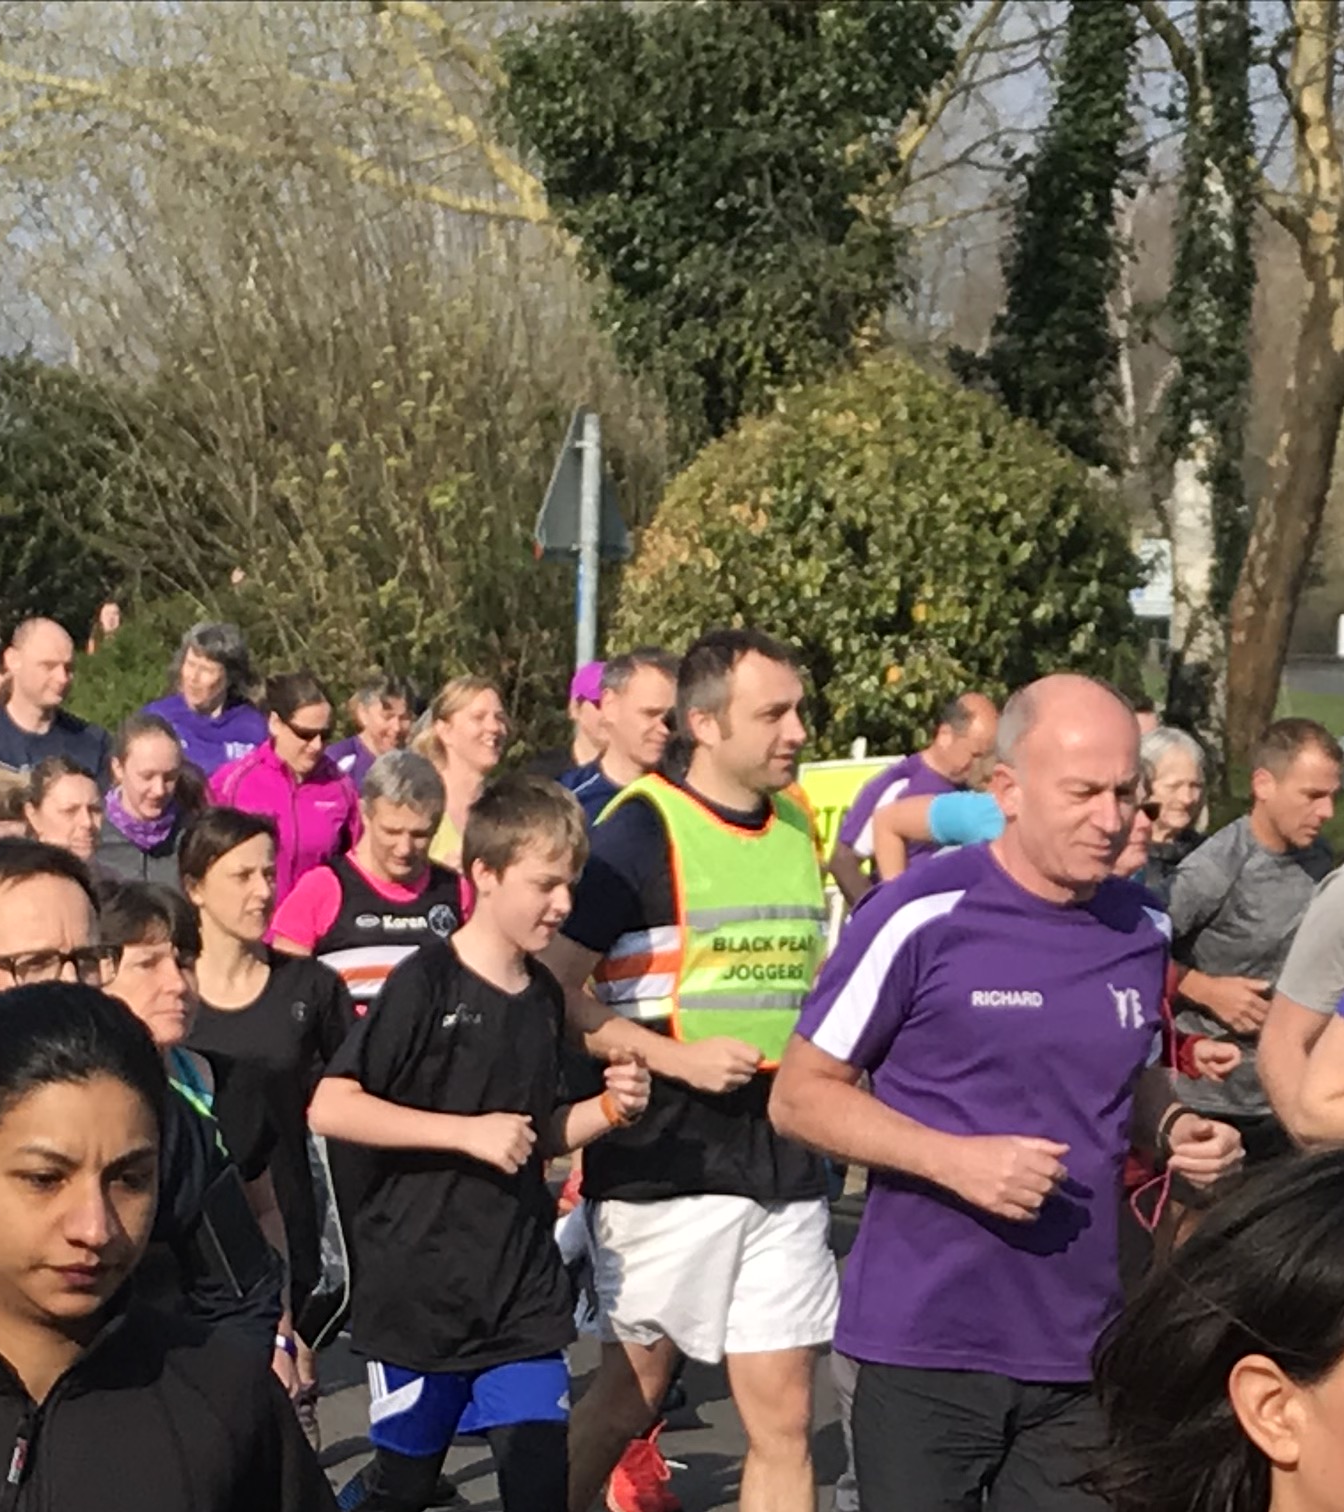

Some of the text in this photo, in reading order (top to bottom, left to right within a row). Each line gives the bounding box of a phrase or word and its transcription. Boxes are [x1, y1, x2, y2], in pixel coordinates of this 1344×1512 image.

[382, 914, 428, 931] Karen
[712, 935, 775, 954] BLACK
[722, 964, 804, 981] JOGGERS
[971, 990, 1044, 1008] RICHARD
